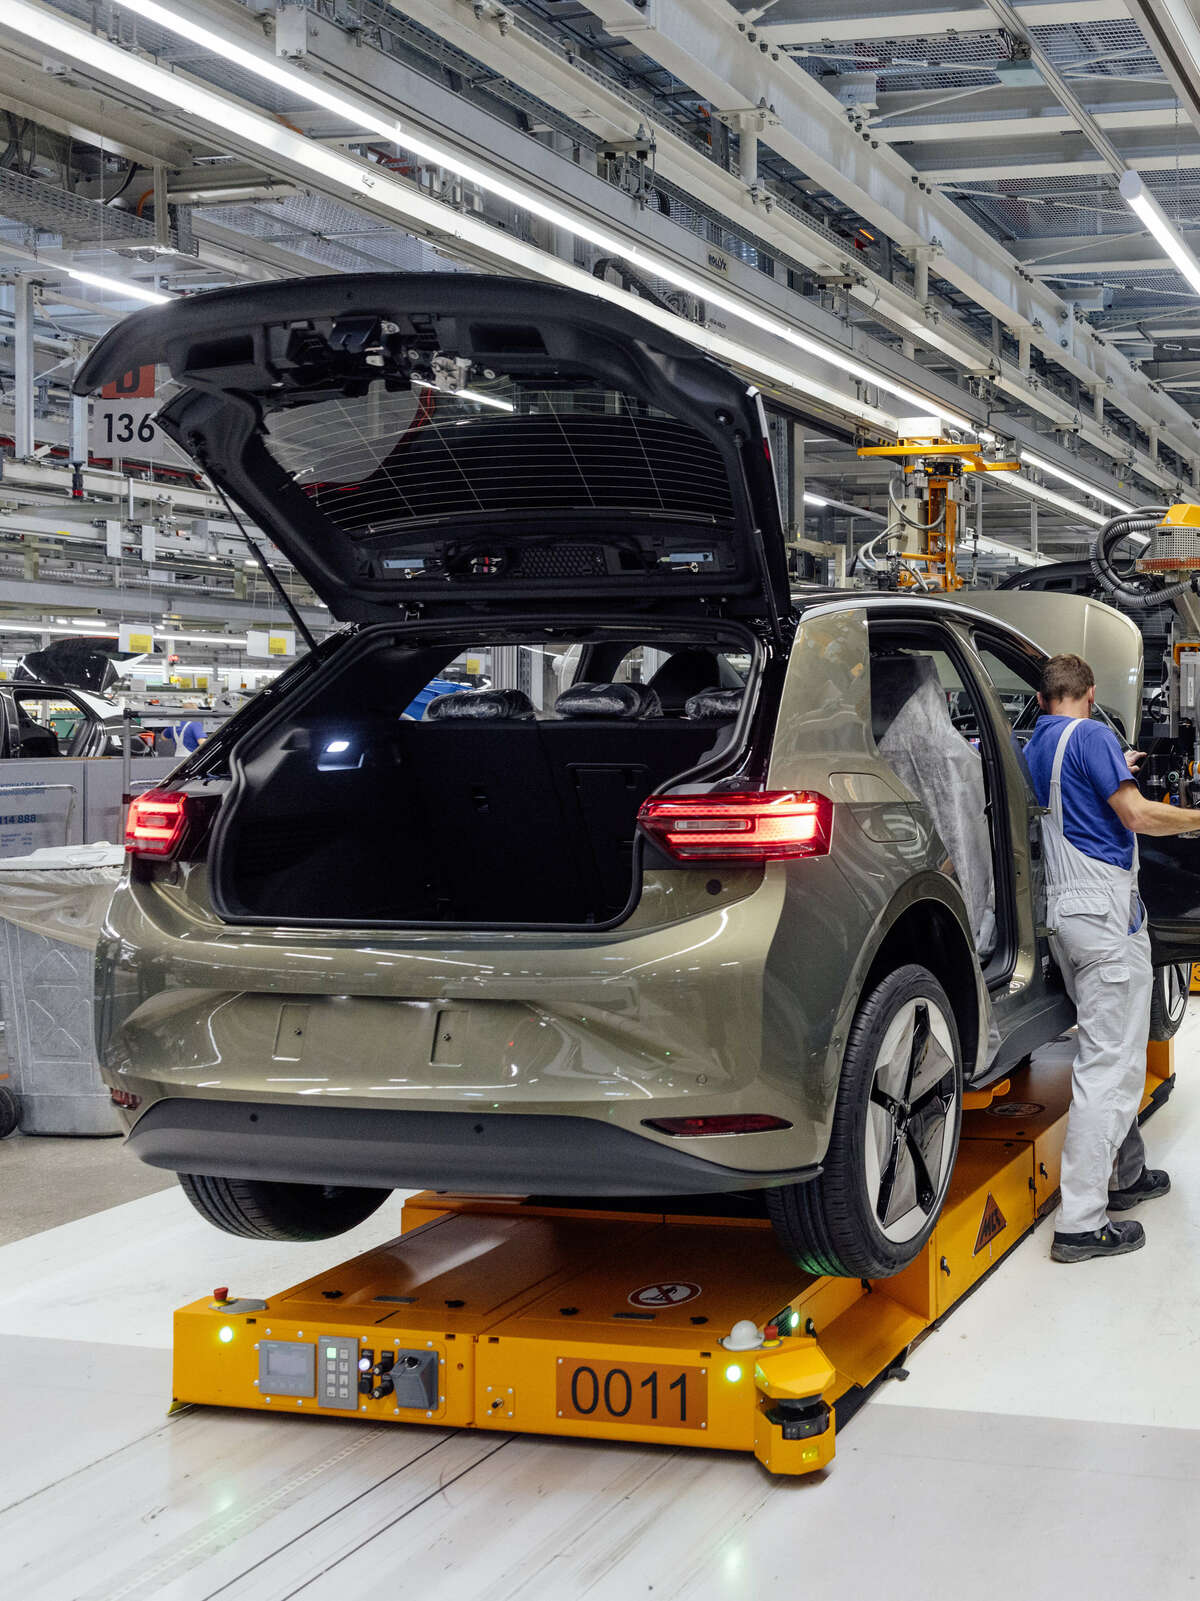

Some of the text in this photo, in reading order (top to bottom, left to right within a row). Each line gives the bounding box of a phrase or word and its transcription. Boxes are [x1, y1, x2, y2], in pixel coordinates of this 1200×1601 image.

[103, 413, 155, 443] 136
[17, 814, 37, 824] 888
[571, 1366, 687, 1421] 0011
